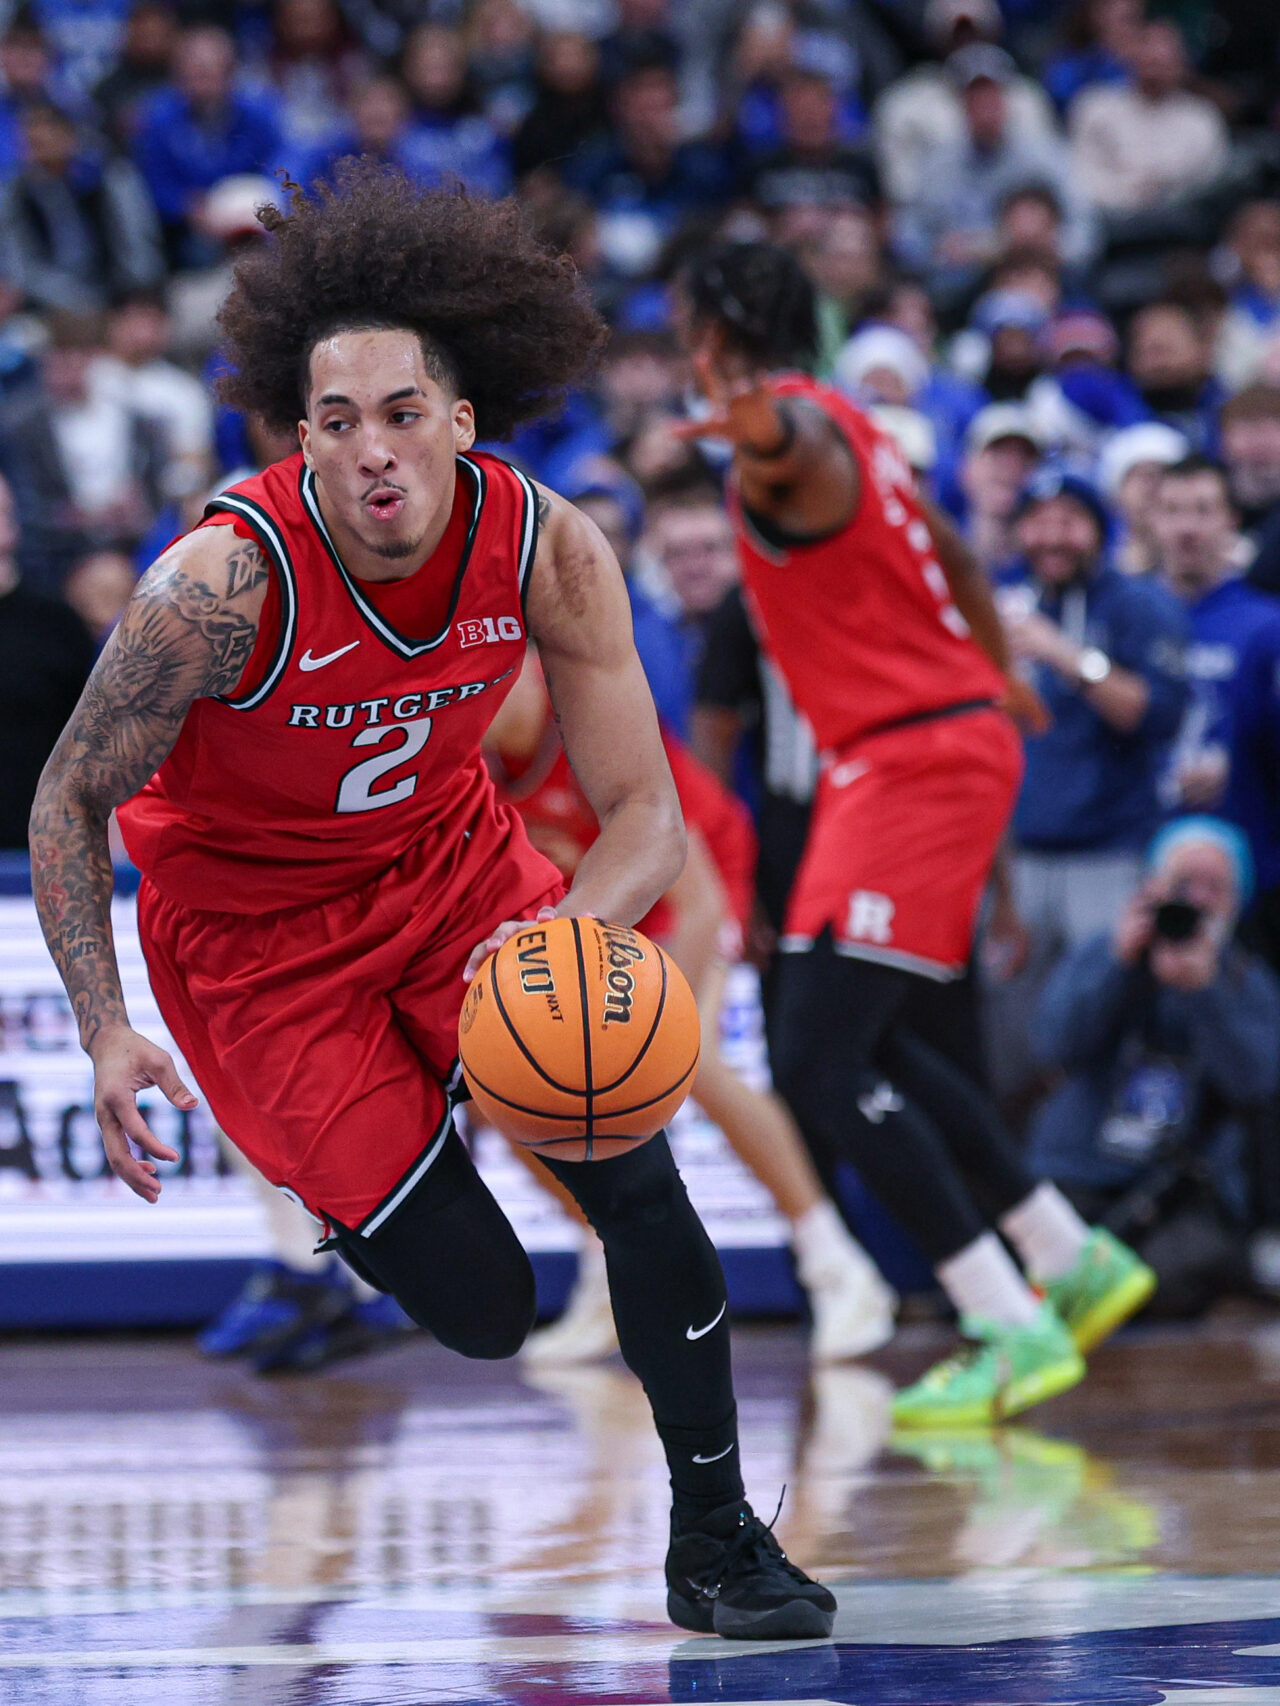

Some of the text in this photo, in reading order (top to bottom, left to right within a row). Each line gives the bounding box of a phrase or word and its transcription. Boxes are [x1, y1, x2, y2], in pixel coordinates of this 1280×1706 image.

[287, 667, 516, 728] RUTGER
[334, 716, 433, 815] 2
[847, 888, 896, 944] R
[517, 931, 556, 996] EVO
[546, 994, 565, 1023] NXT
